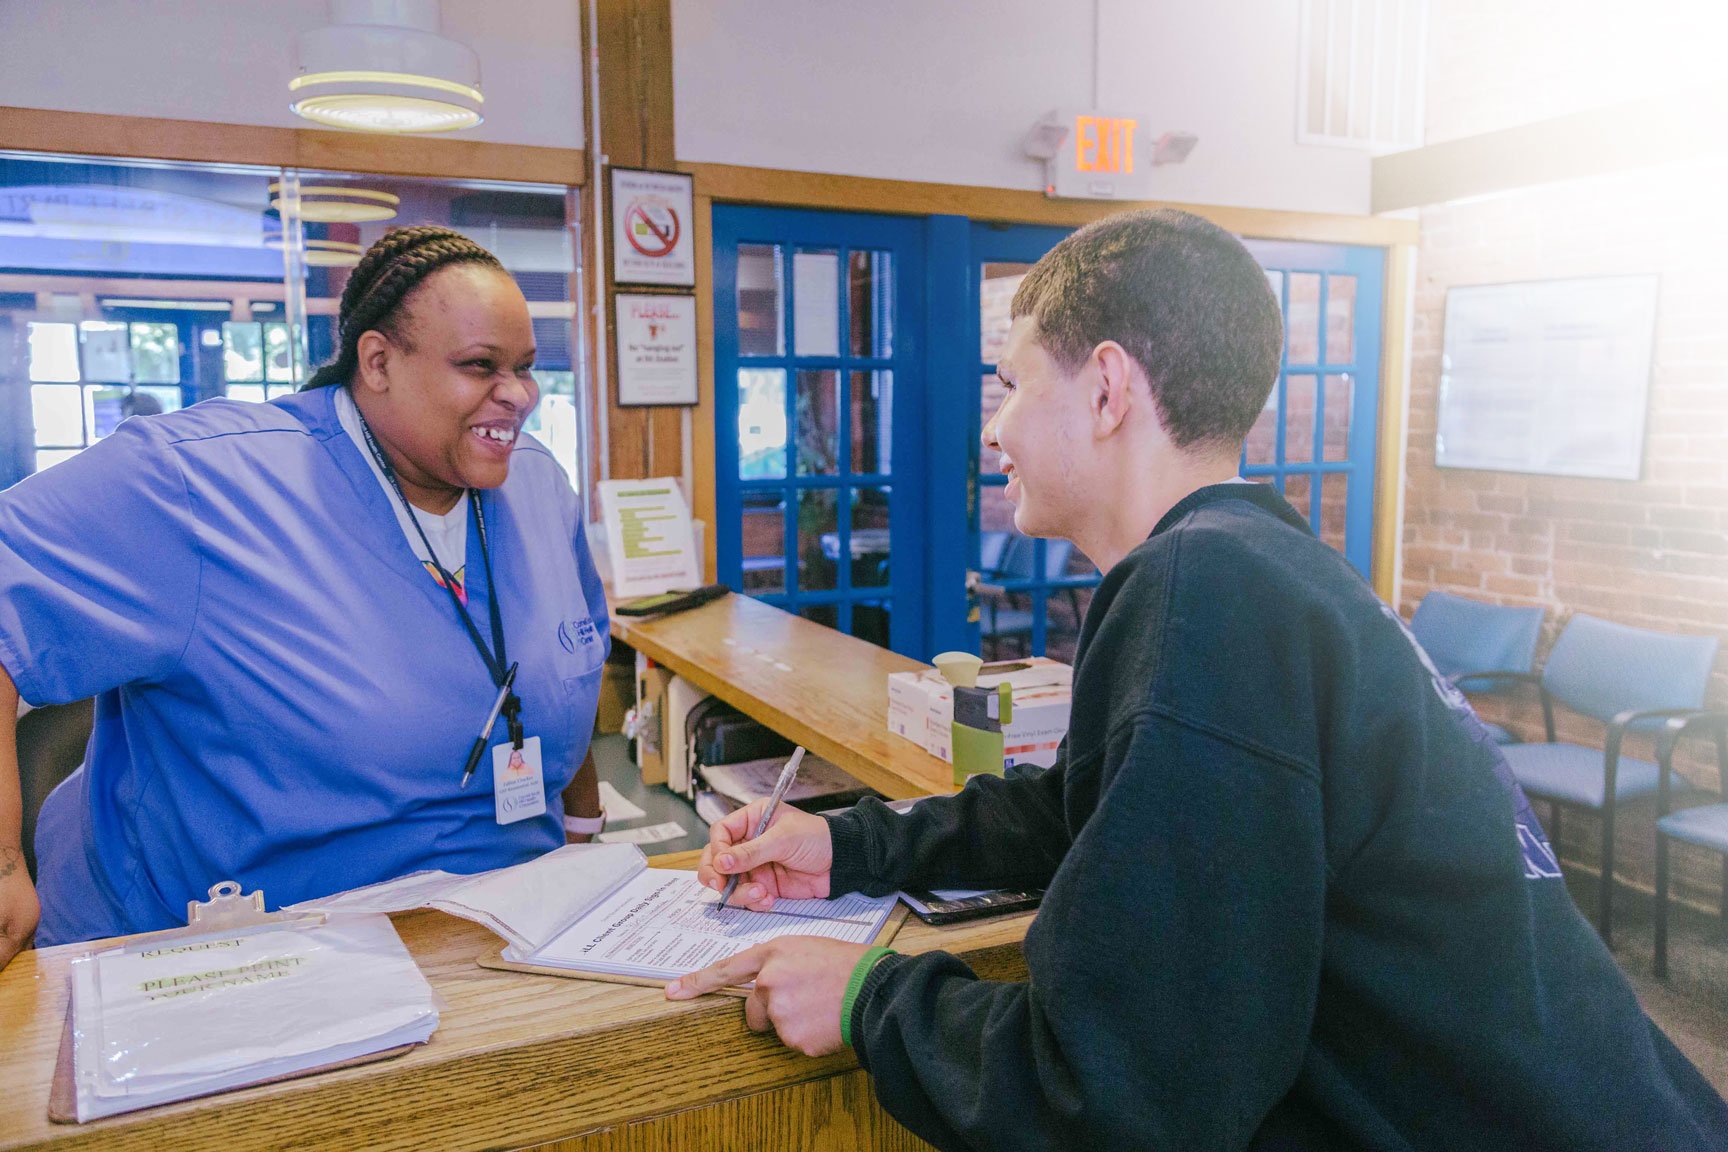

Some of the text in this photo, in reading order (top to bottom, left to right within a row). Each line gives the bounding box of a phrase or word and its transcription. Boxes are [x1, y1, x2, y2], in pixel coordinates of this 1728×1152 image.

[1076, 115, 1137, 174] EXIT
[593, 928, 615, 942] Client
[612, 913, 634, 928] Group
[630, 902, 650, 913] Daily
[141, 938, 244, 957] REQUEST
[143, 957, 305, 992] PLEASE PRINT
[221, 969, 290, 987] NAME
